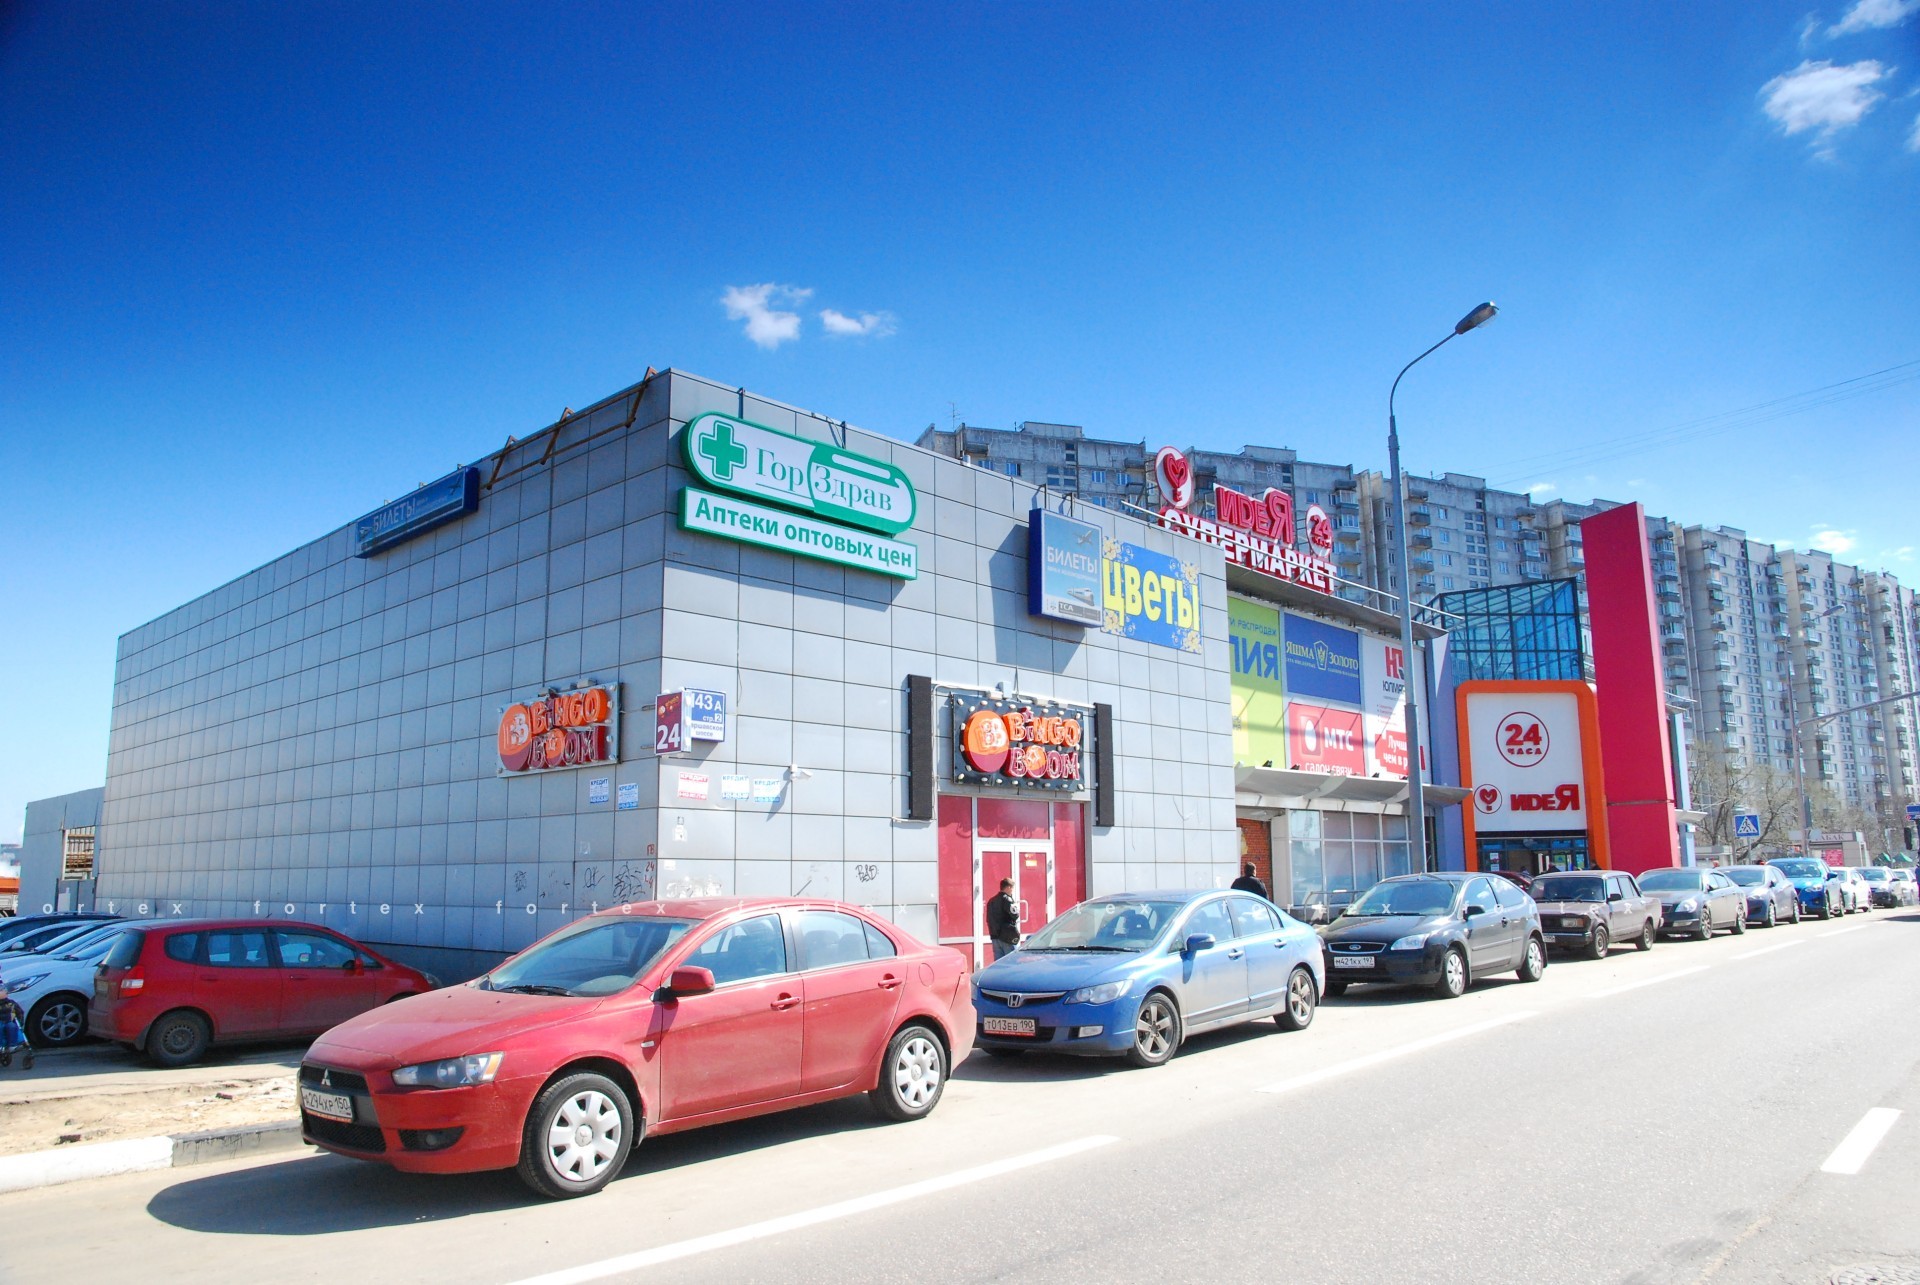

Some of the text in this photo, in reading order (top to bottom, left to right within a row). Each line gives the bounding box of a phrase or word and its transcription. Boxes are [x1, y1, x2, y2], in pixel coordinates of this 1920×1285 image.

[373, 497, 416, 532] БИЛЕТЫ
[1310, 515, 1332, 540] 24
[695, 498, 912, 567] Аптеки оптовых цен
[1047, 546, 1097, 574] БИЛЕТЫ
[1158, 506, 1338, 594] СУПЕРМАРКЕТ
[1286, 641, 1315, 660] ЯШМА
[1328, 652, 1359, 670] ЗОЛОТО
[657, 722, 681, 750] 24
[1324, 727, 1354, 752] МТС
[1505, 723, 1542, 746] 24
[1008, 744, 1080, 780] BOOM
